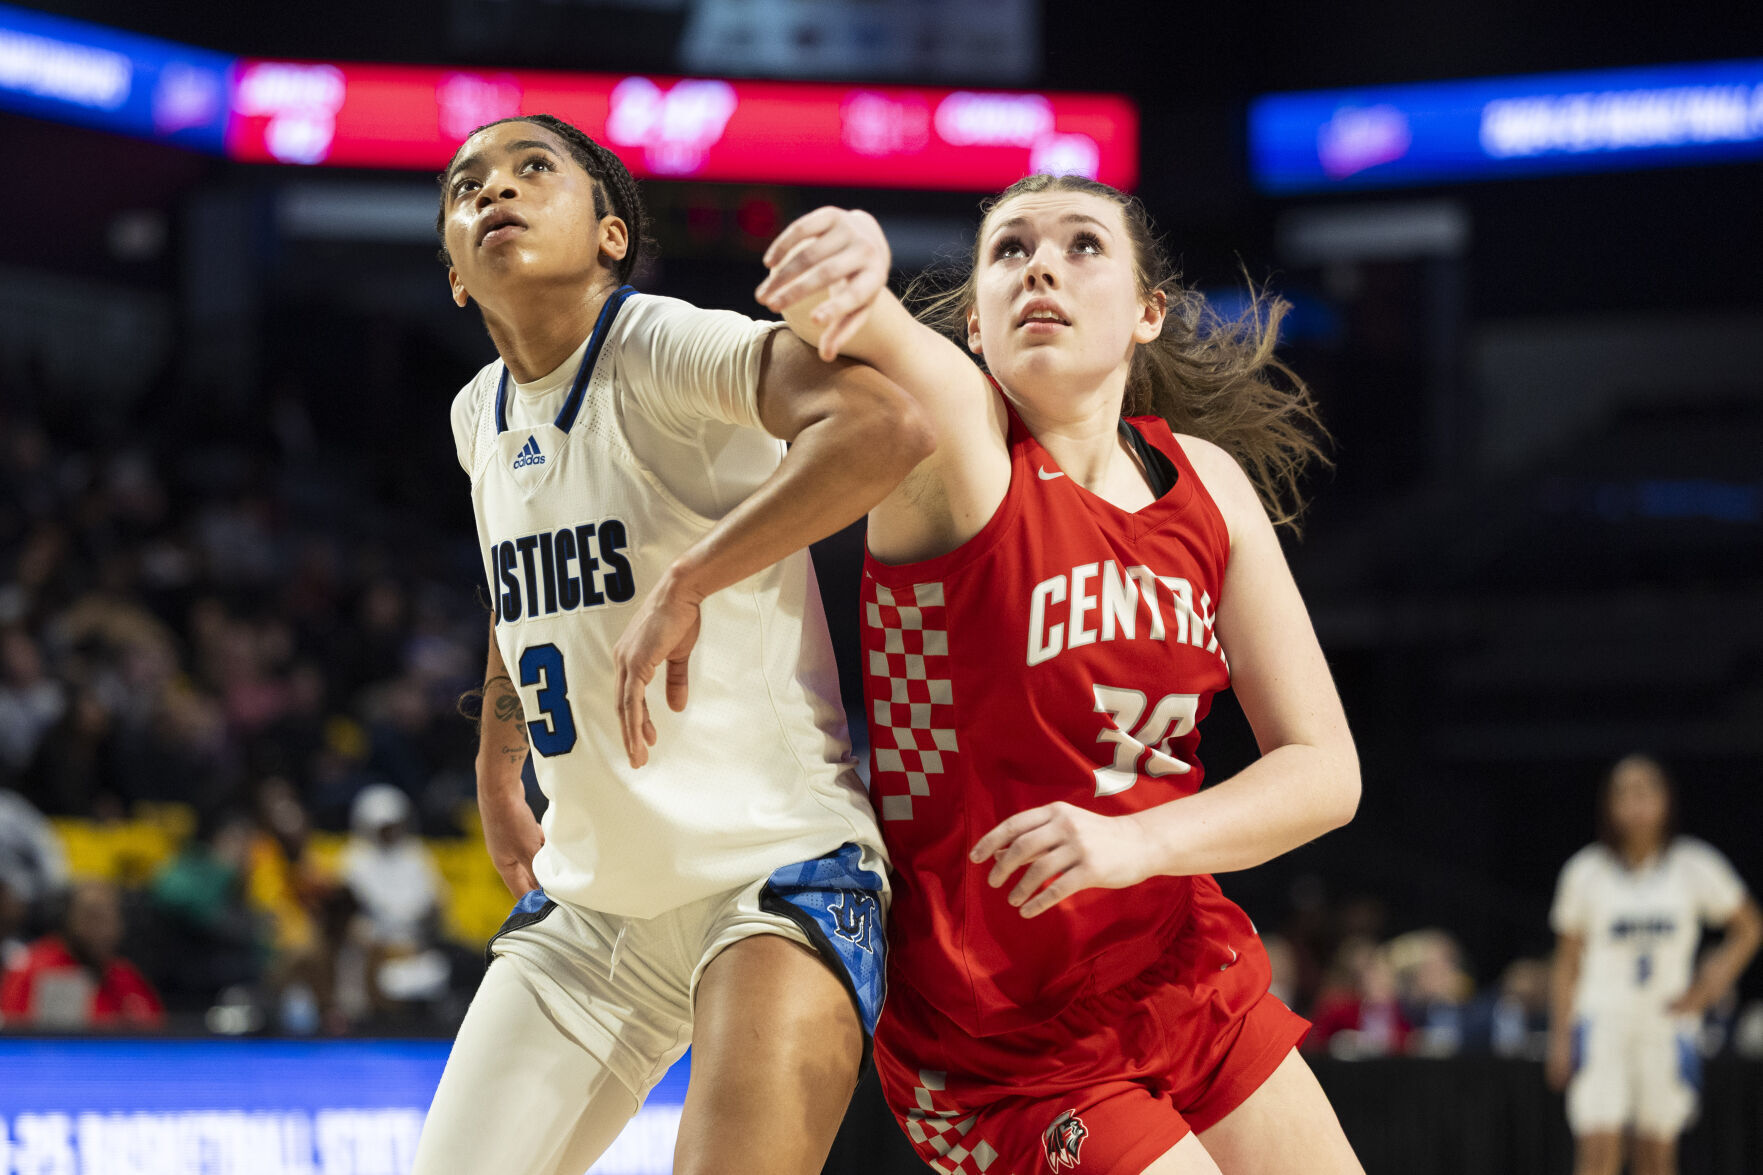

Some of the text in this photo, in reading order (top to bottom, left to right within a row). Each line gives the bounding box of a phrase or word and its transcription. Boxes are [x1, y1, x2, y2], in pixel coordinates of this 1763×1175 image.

[513, 454, 546, 470] adidas
[518, 642, 578, 758] 3
[1092, 682, 1200, 799] 30
